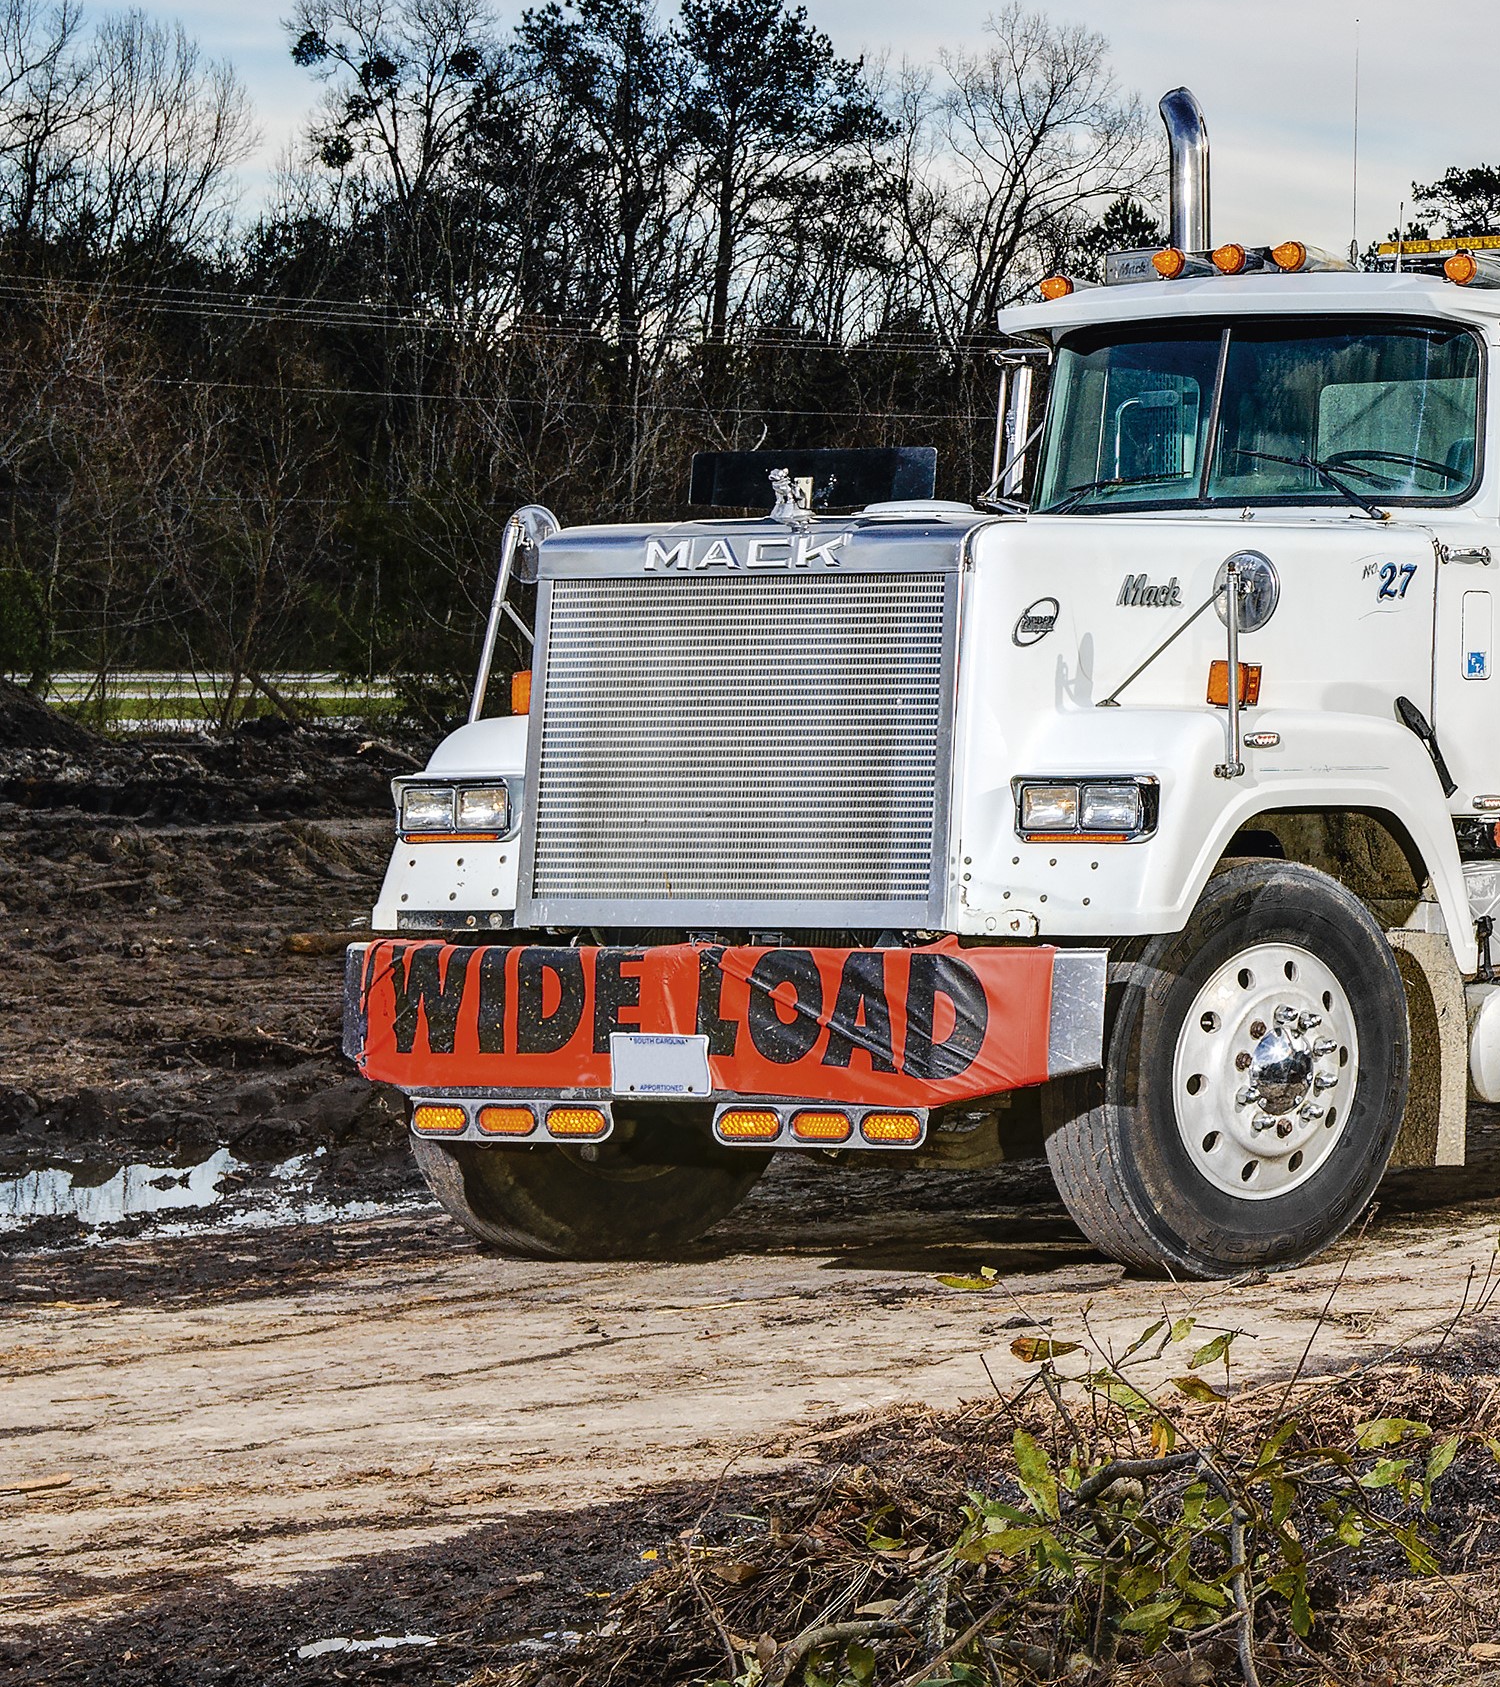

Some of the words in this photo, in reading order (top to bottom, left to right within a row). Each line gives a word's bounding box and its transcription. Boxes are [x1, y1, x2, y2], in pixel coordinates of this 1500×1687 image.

[644, 534, 852, 571] MACK
[1116, 574, 1182, 607] Mack
[1379, 562, 1418, 600] 27
[393, 946, 643, 1055] WIDE
[696, 947, 989, 1080] LOAD
[640, 1084, 684, 1092] APPORTIONED
